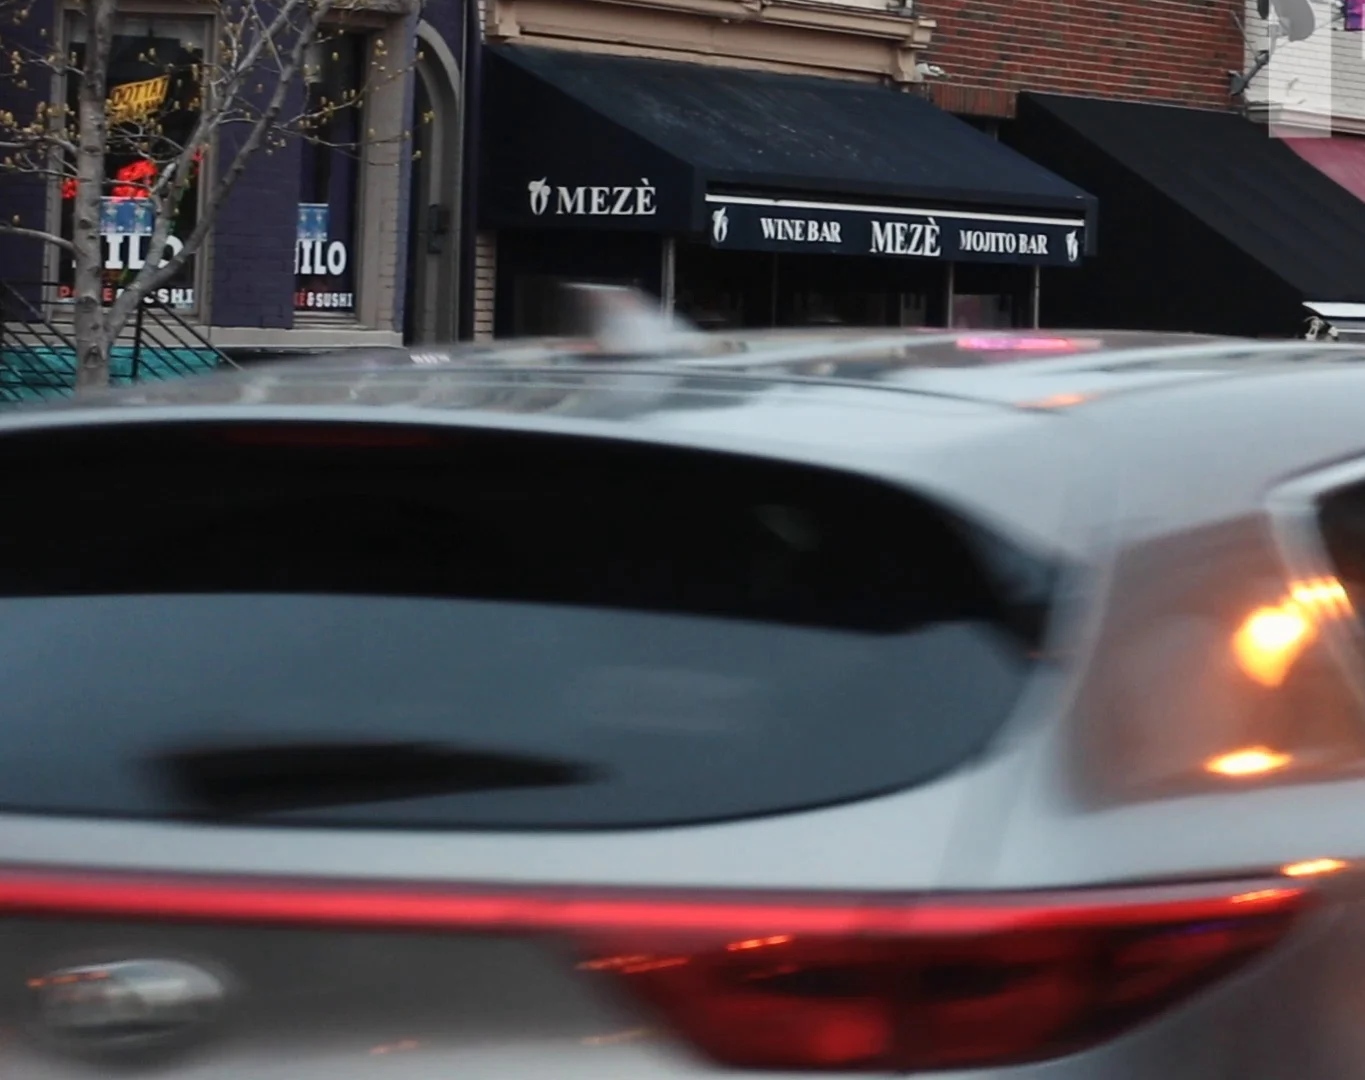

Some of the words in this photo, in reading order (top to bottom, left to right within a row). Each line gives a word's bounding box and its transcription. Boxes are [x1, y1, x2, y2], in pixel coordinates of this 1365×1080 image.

[556, 178, 657, 215] MEZÈ
[760, 218, 805, 242] WINE
[807, 220, 842, 243] BAR
[869, 217, 942, 257] MEZÈ
[959, 229, 1017, 254] MOJITO
[1018, 233, 1049, 255] BAR
[294, 240, 348, 276] ILO
